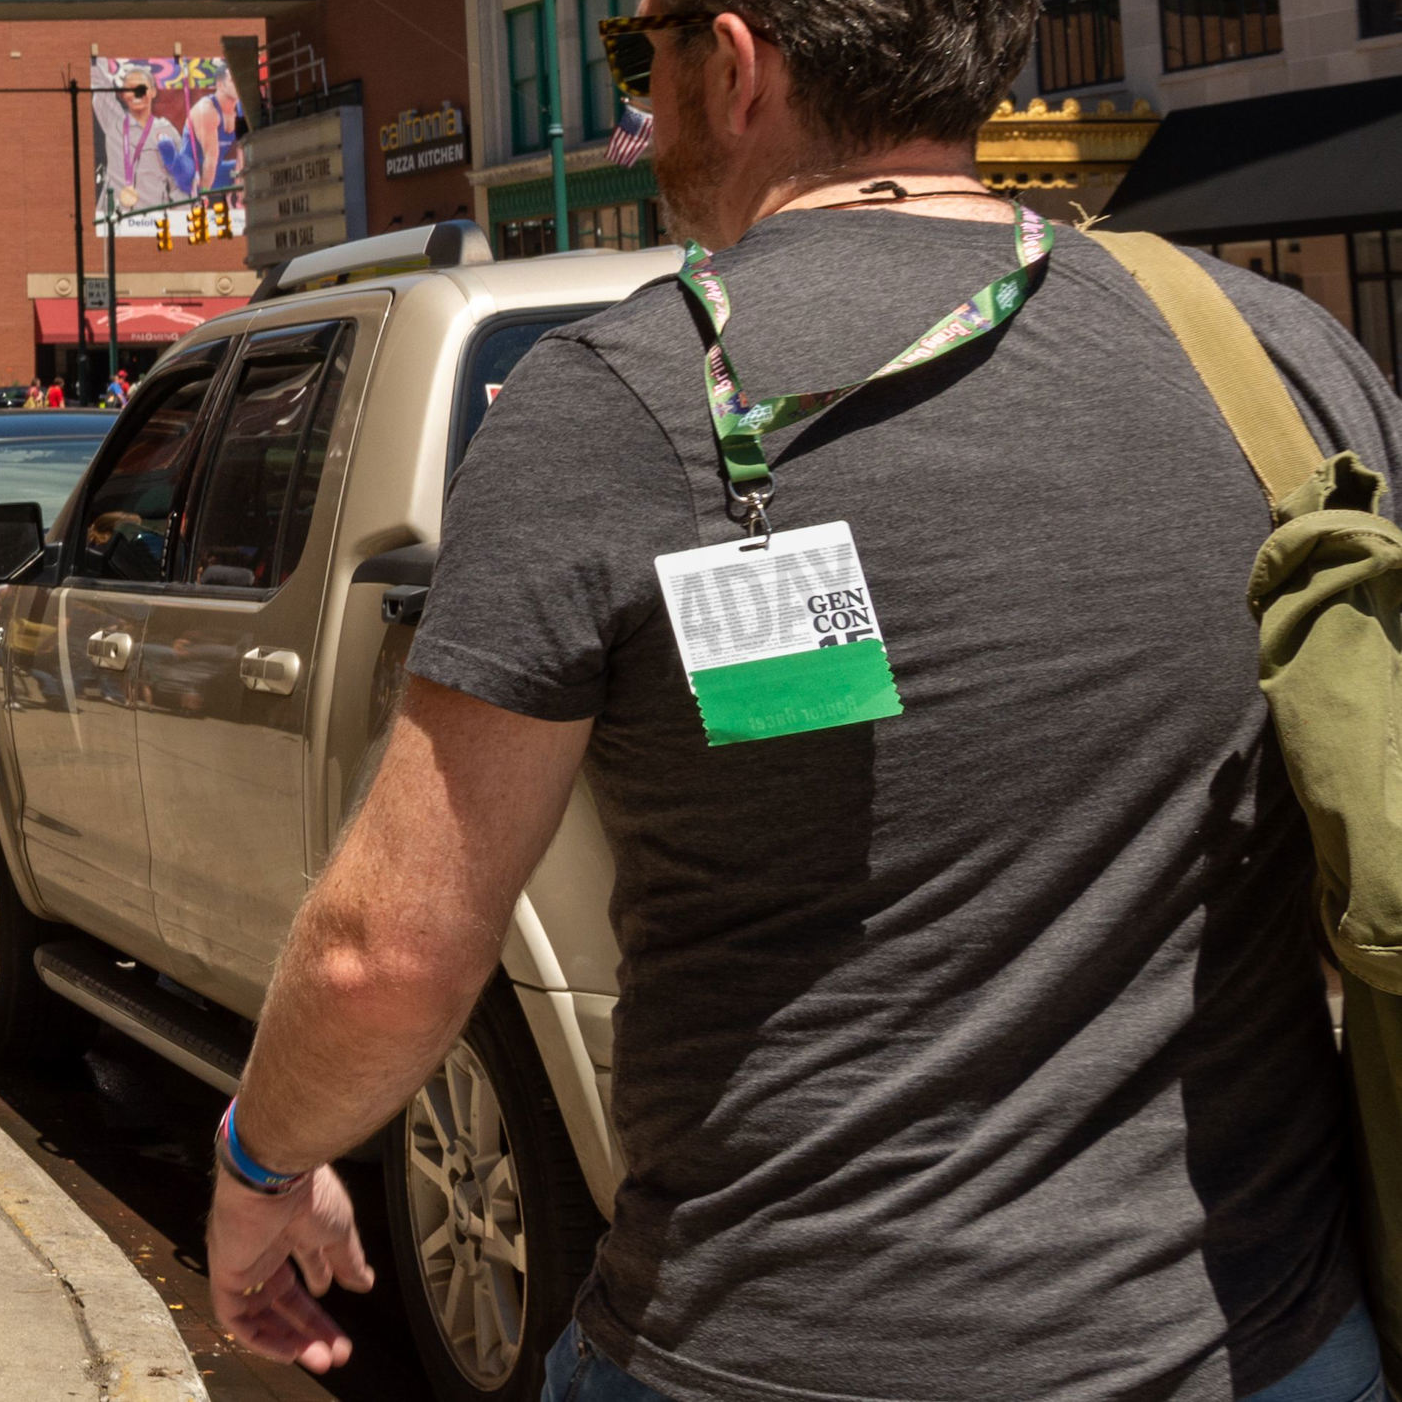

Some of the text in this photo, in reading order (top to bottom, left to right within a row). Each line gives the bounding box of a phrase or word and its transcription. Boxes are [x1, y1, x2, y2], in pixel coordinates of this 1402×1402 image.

[386, 143, 464, 176] PIZZA KITCHEN
[128, 218, 156, 228] Deloi
[88, 281, 107, 290] ONE
[807, 587, 866, 615] GEN
[812, 607, 874, 634] CON
